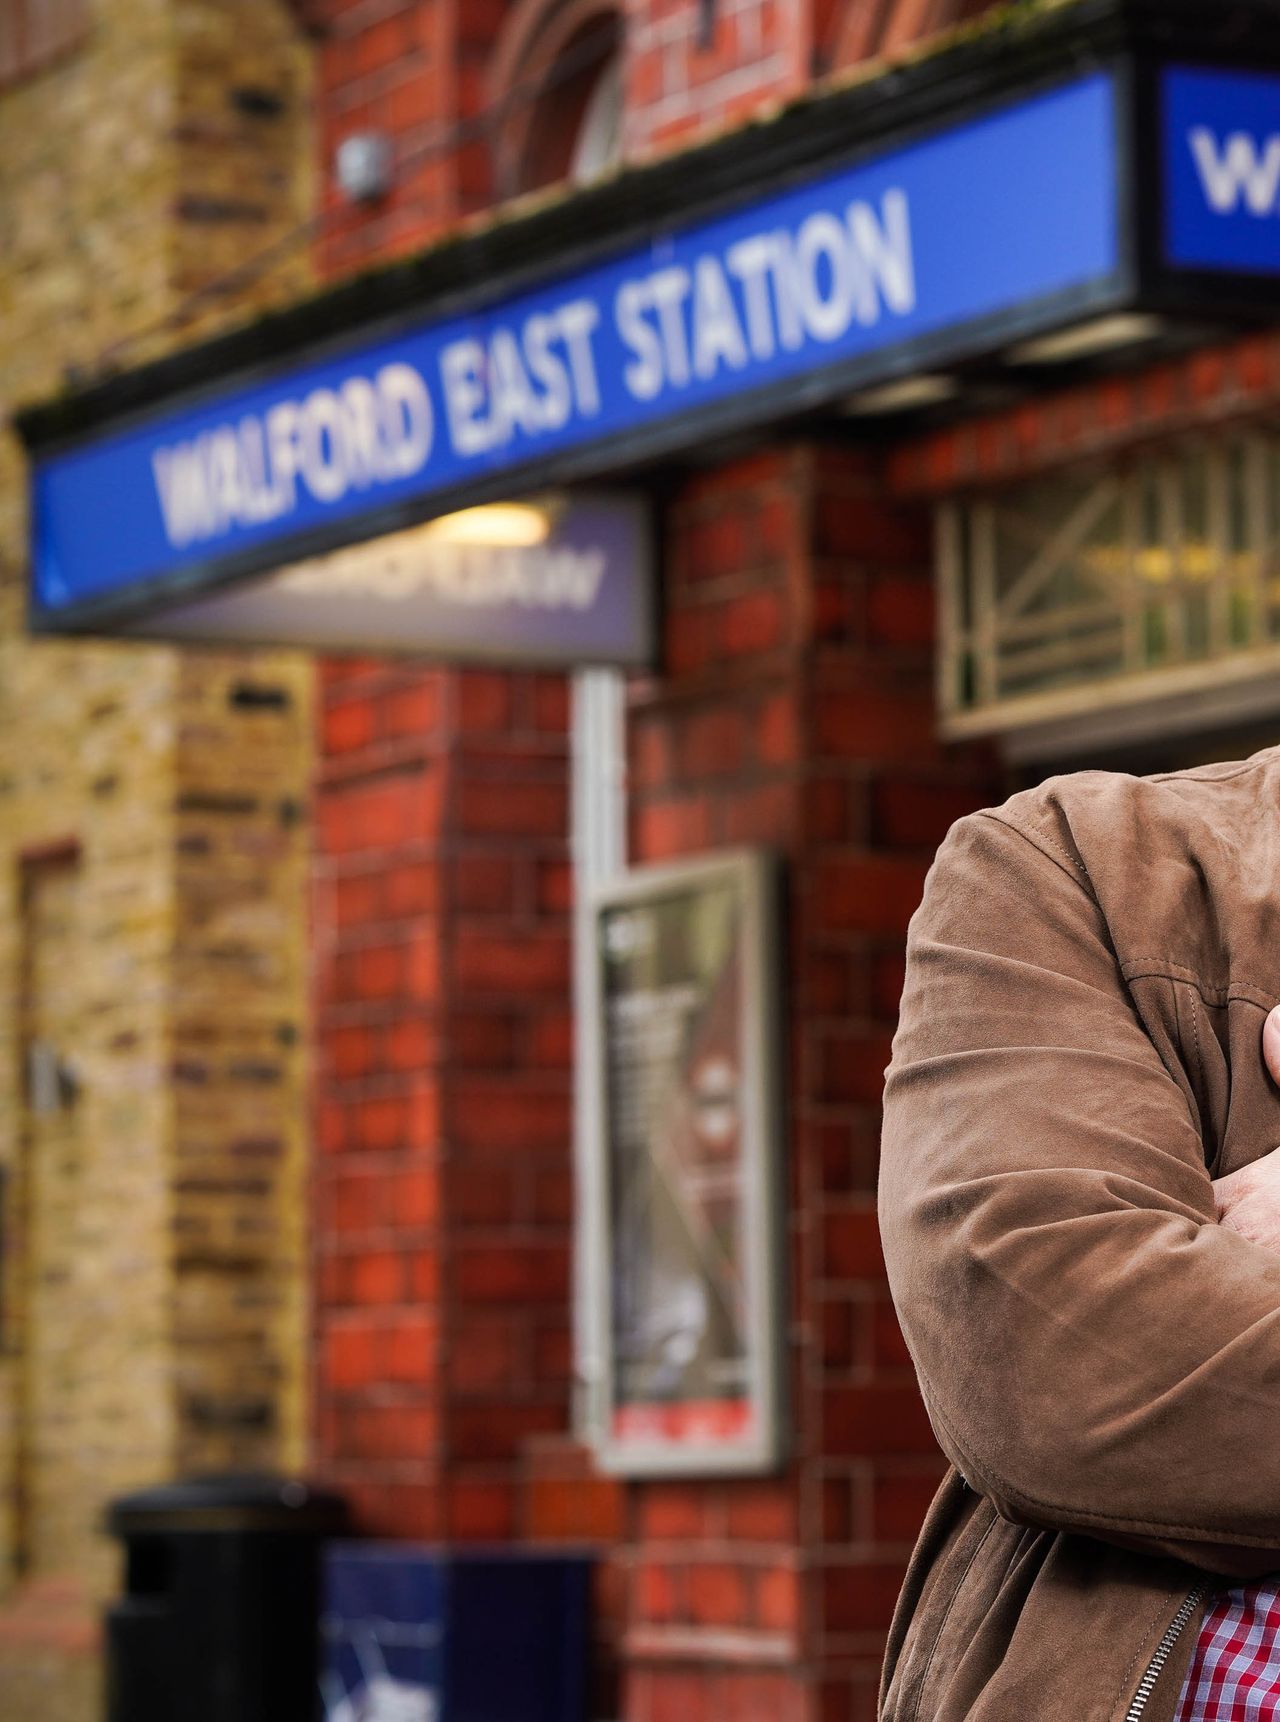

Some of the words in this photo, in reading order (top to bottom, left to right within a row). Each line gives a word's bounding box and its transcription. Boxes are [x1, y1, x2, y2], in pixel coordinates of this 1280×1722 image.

[153, 363, 434, 548] WALFORD
[440, 300, 600, 455] EAST
[615, 189, 914, 400] STATION
